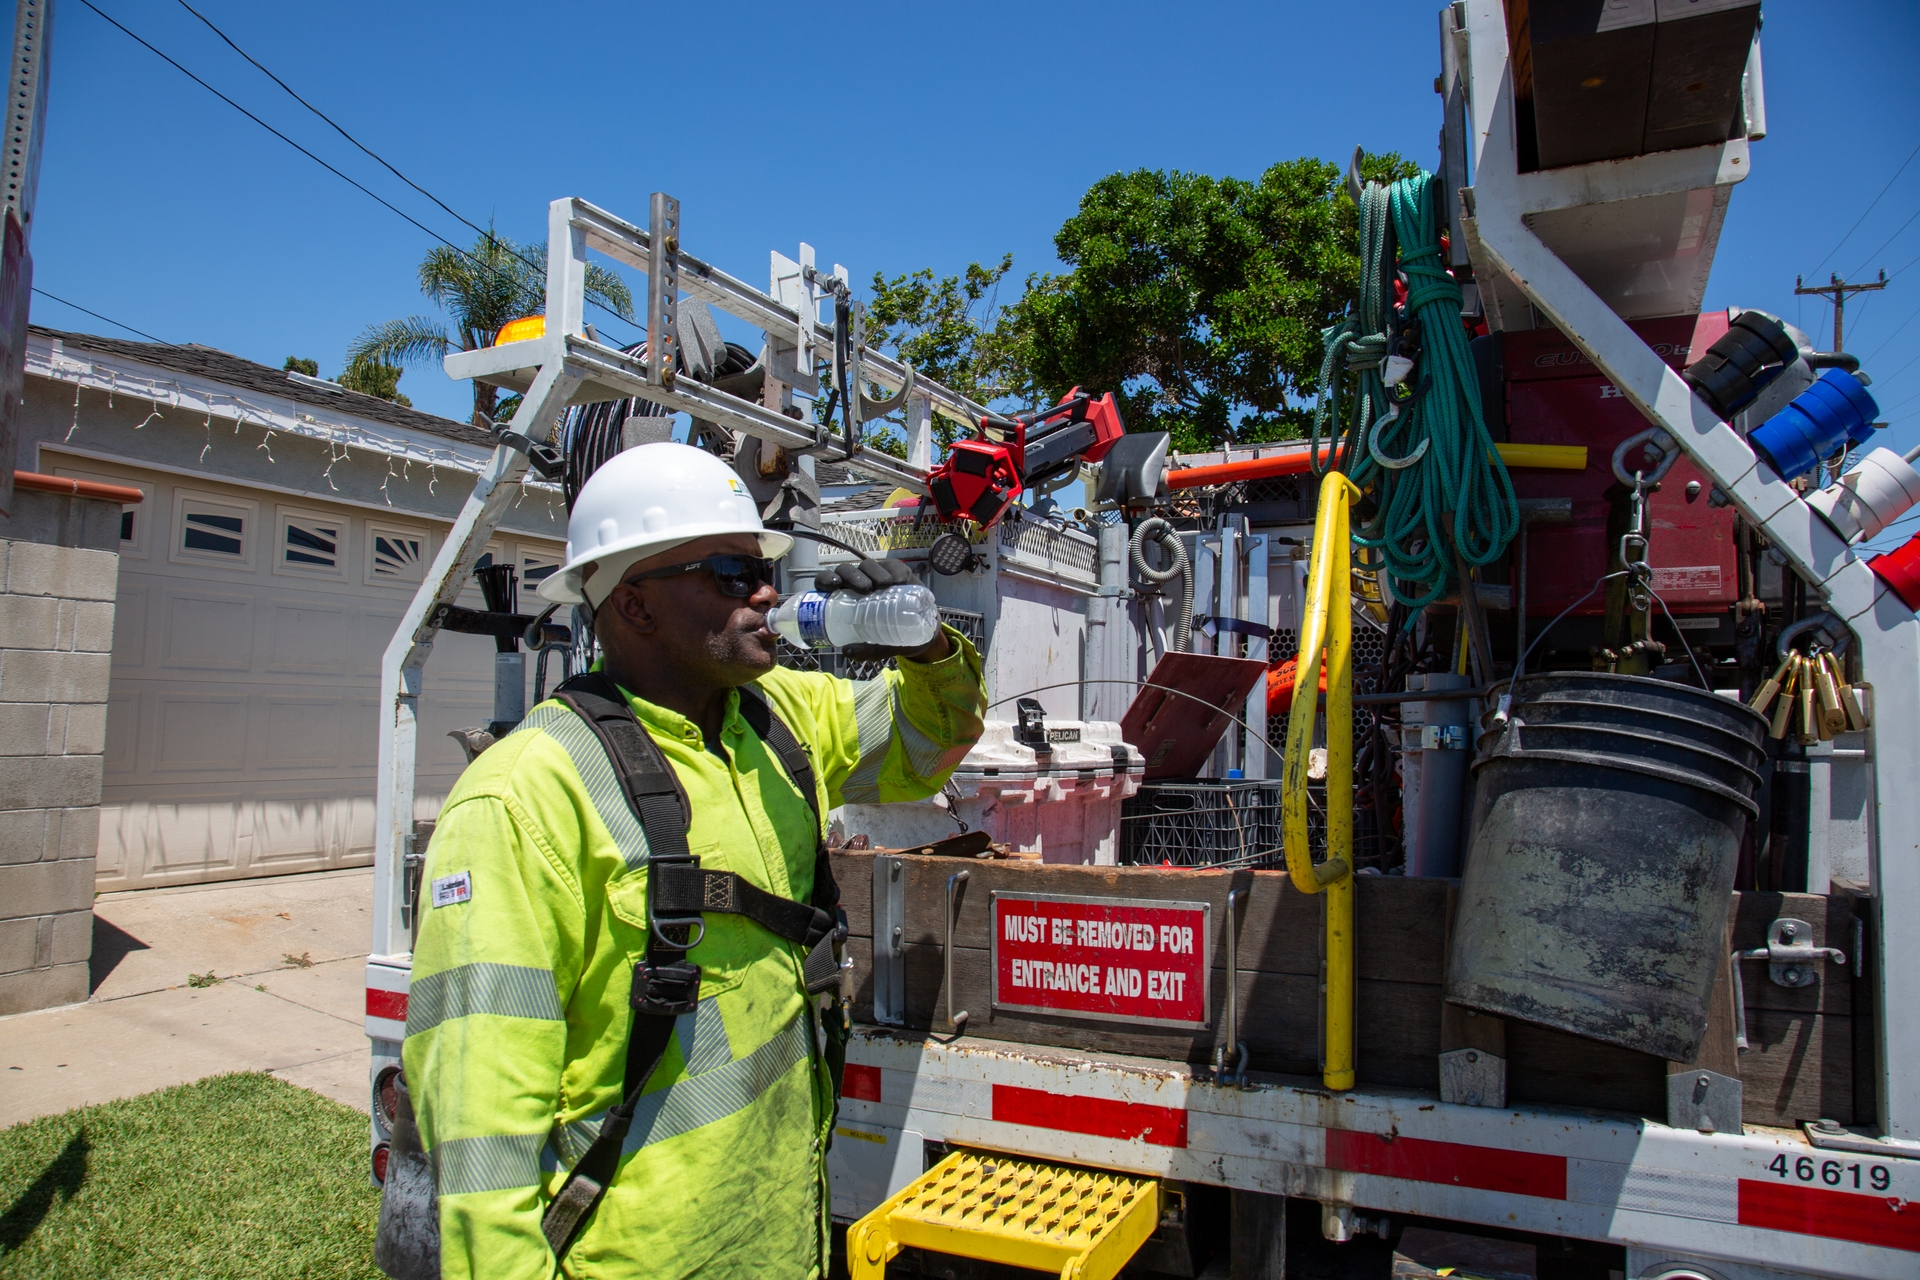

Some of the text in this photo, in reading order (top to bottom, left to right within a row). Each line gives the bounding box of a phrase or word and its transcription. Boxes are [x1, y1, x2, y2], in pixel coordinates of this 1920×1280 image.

[1050, 731, 1078, 740] PELICAN
[1005, 914, 1193, 954] MUST BE REMOVED FOR
[1011, 958, 1186, 1001] ENTRANCE AND EXIT
[1769, 1153, 1891, 1191] 46619
